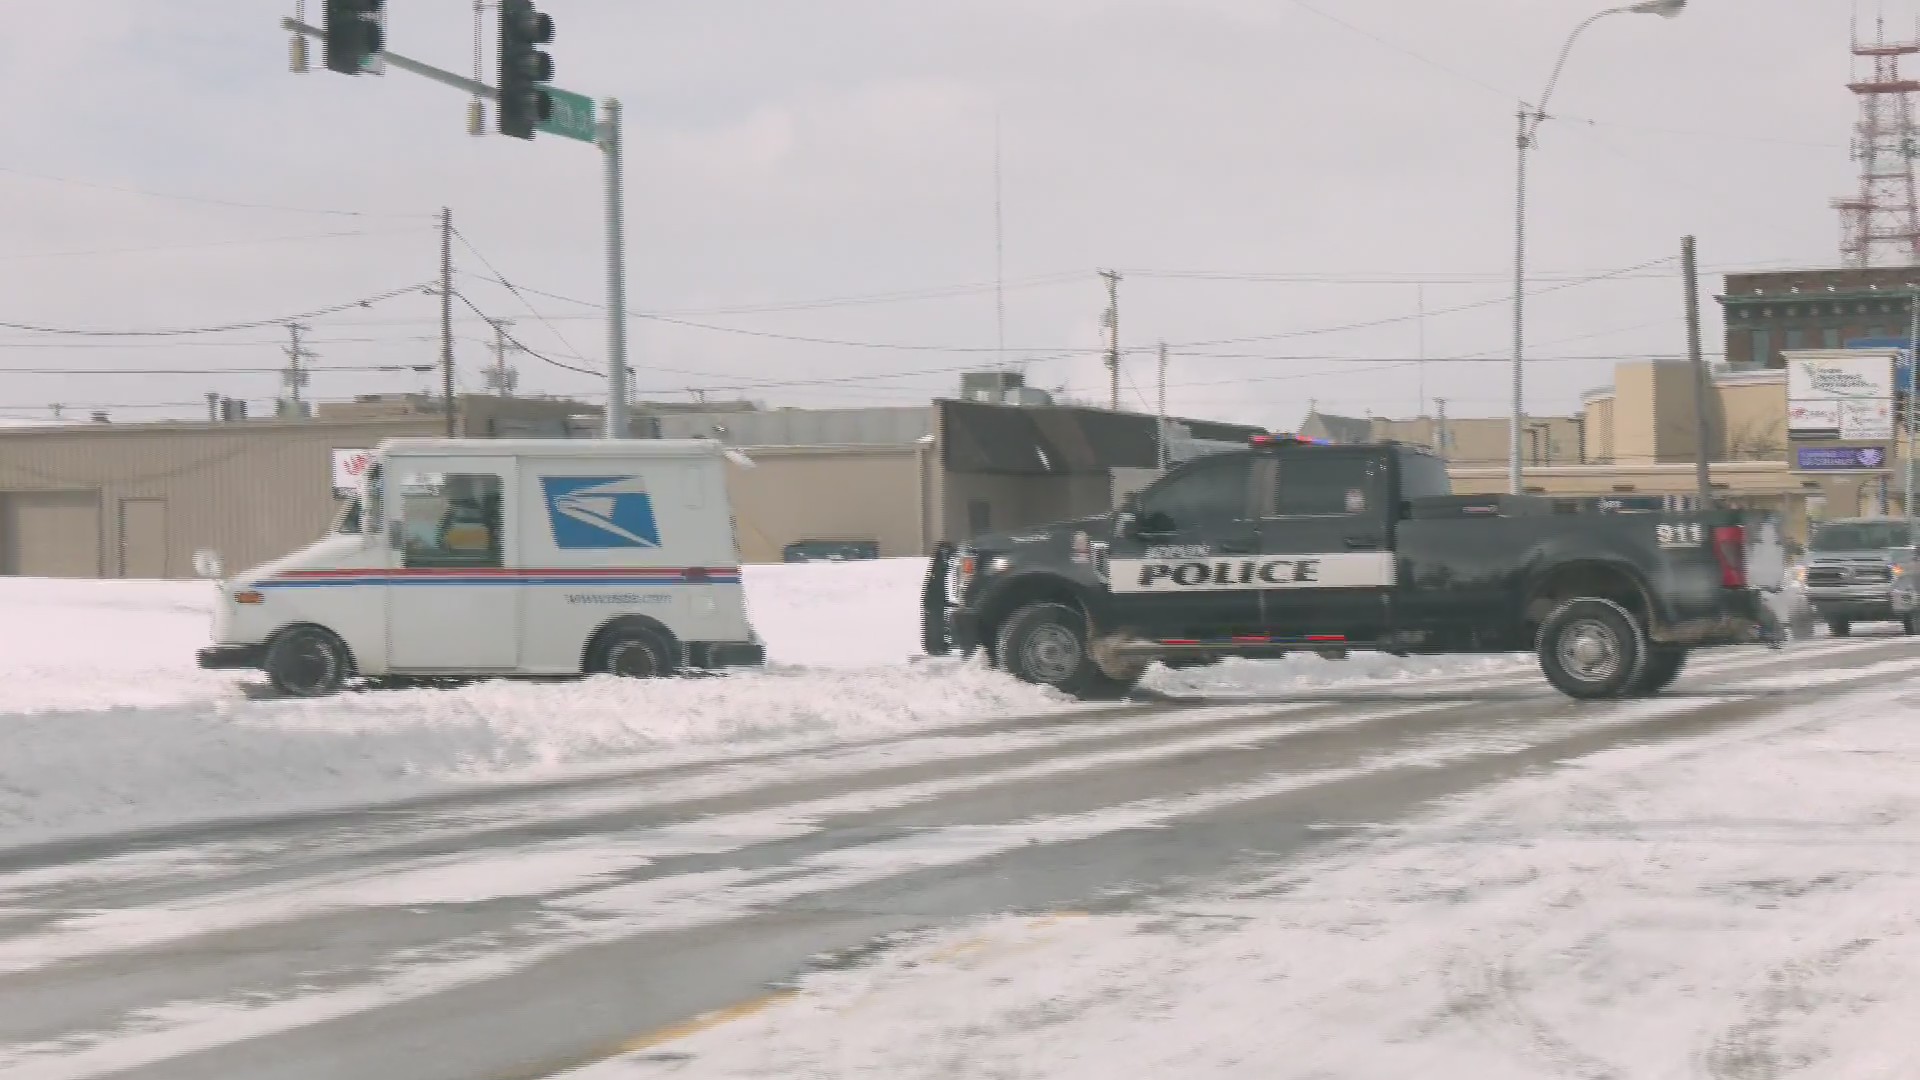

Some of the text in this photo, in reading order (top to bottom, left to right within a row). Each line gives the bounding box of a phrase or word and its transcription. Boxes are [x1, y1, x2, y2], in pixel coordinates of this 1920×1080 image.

[1655, 524, 1702, 544] 911
[1144, 544, 1211, 560] JOPLIN
[1137, 560, 1322, 589] POLICE
